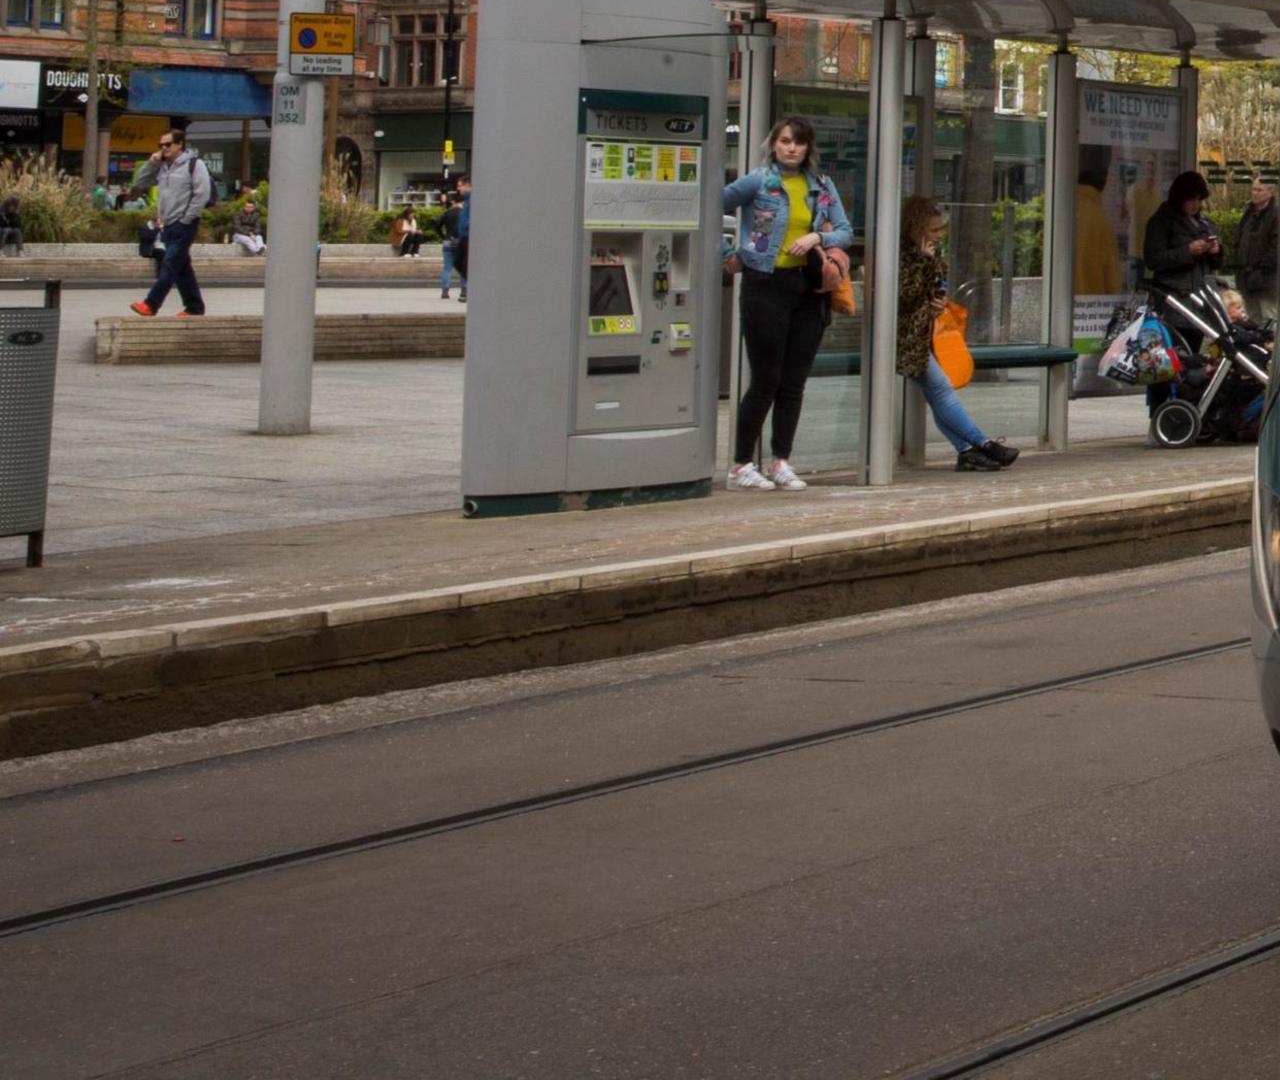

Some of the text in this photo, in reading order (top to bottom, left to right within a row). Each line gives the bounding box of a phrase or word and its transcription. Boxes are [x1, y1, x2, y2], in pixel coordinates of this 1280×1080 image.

[316, 56, 342, 65] loading
[281, 86, 300, 96] OM
[283, 100, 295, 110] 11
[1084, 90, 1169, 118] WE NEED YOU
[279, 113, 299, 123] 352
[596, 114, 691, 132] TICKETS NET
